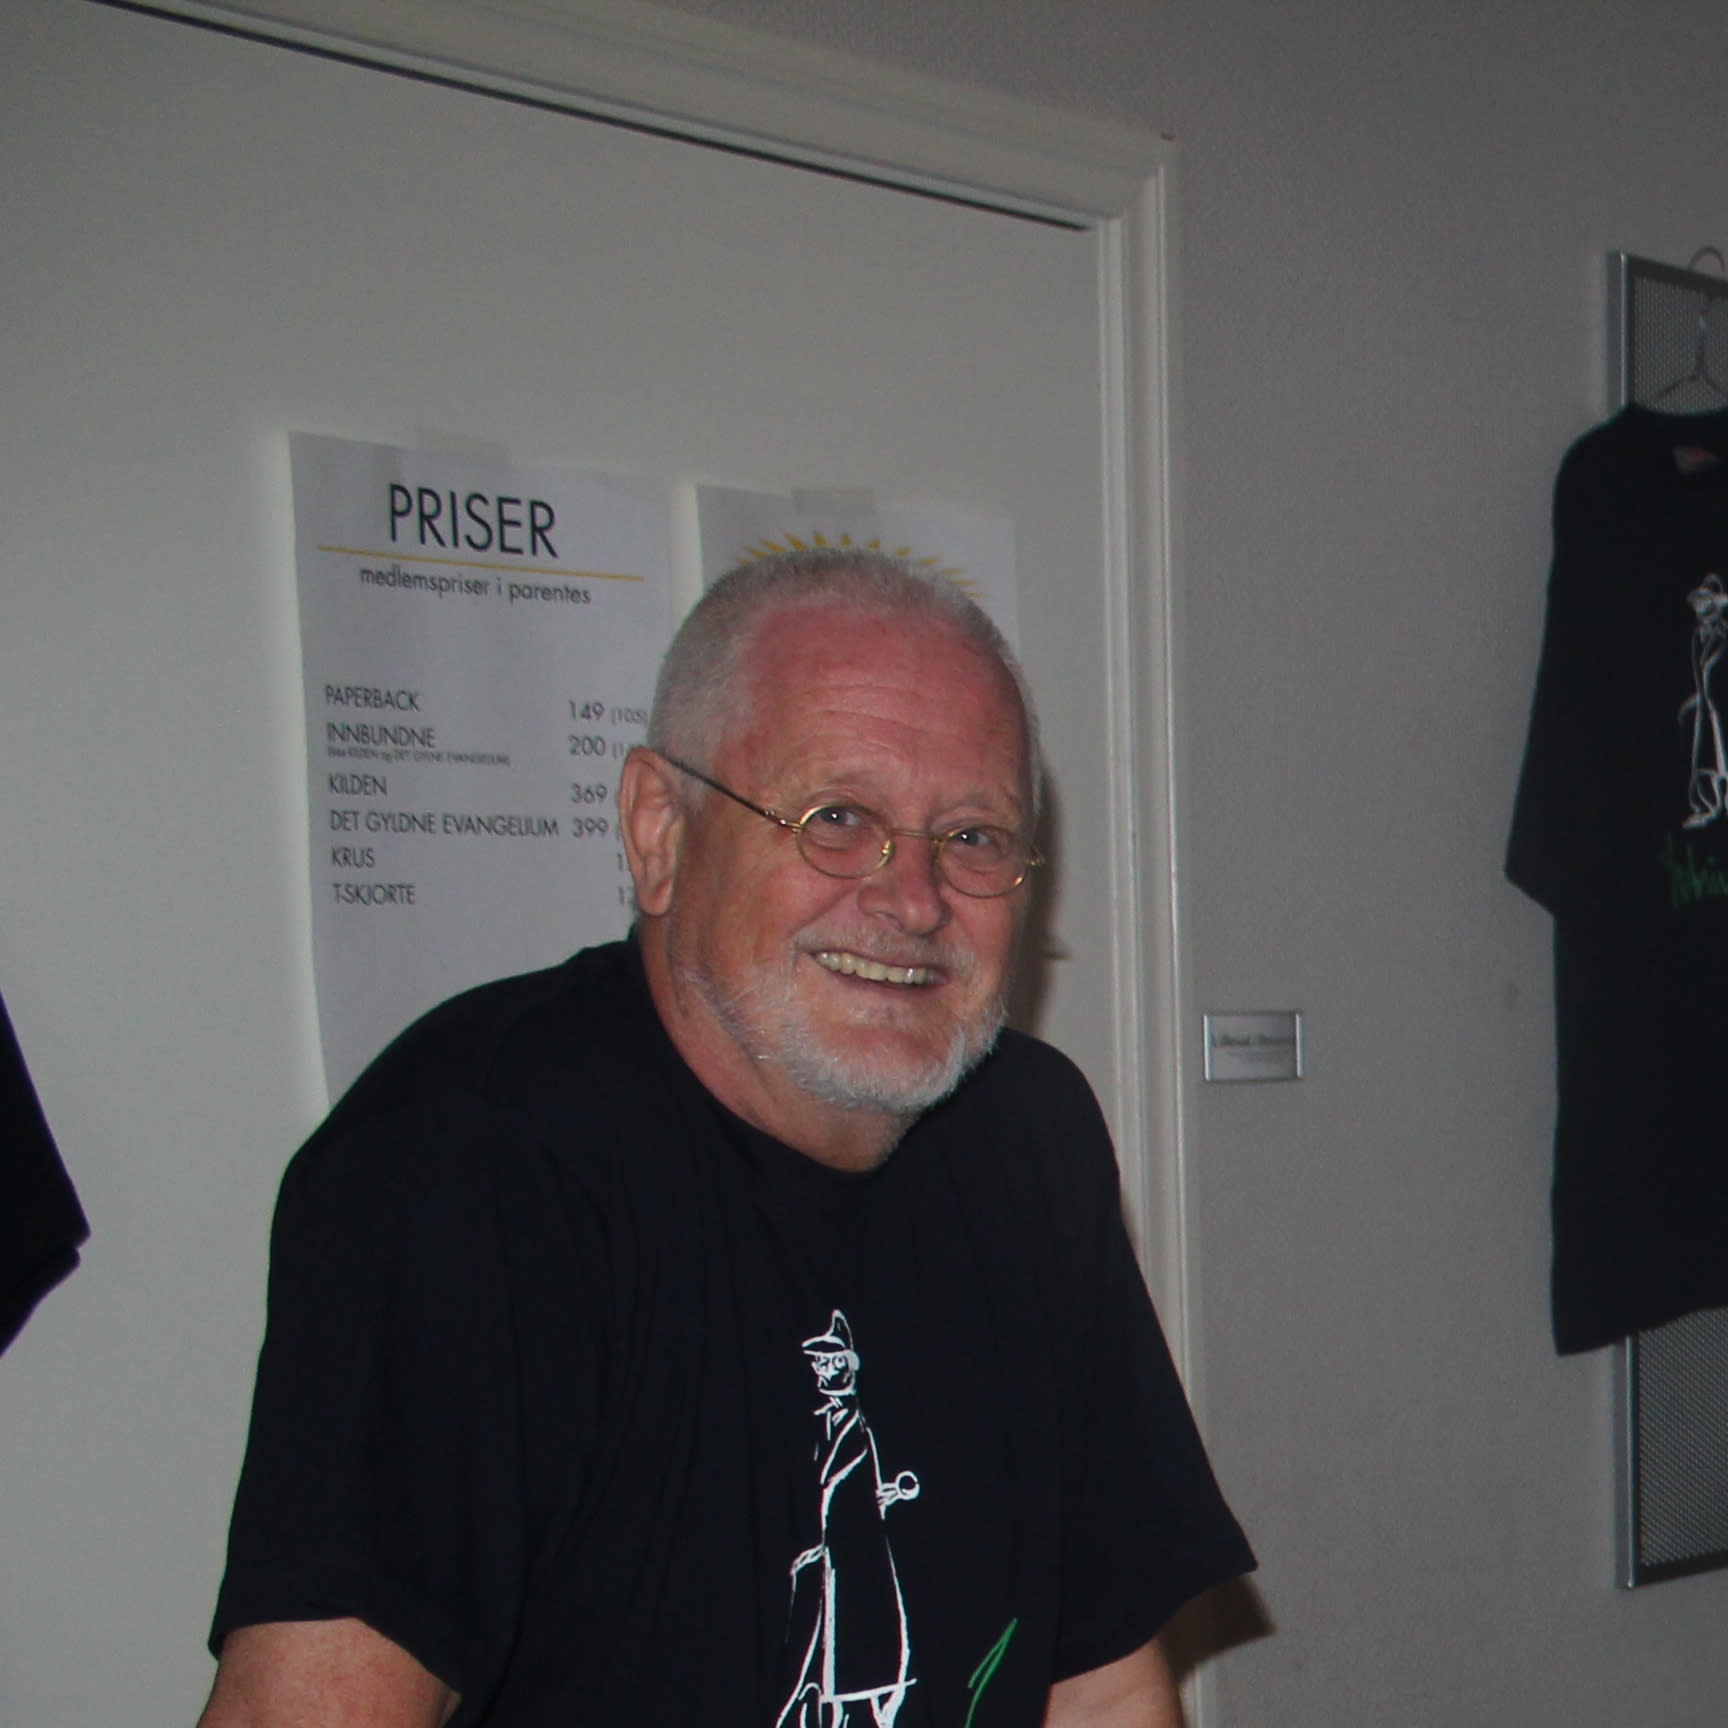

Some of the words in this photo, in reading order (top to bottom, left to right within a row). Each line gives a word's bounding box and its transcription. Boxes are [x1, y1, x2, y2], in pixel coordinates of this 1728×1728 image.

[388, 482, 559, 558] PRISER
[359, 564, 490, 597] medlemspriser
[509, 583, 592, 604] parentes
[324, 684, 421, 712] PAPERBACK
[568, 700, 605, 721] 149
[326, 721, 436, 749] INNBUNDNE
[568, 735, 606, 757] 200
[327, 773, 387, 796] KILDEN
[570, 783, 608, 804] 369
[330, 810, 360, 832] DET
[365, 812, 437, 835] GYLDNE
[442, 814, 560, 837] EVANGELIUM
[571, 817, 609, 838] 399
[331, 847, 376, 868] KRUS
